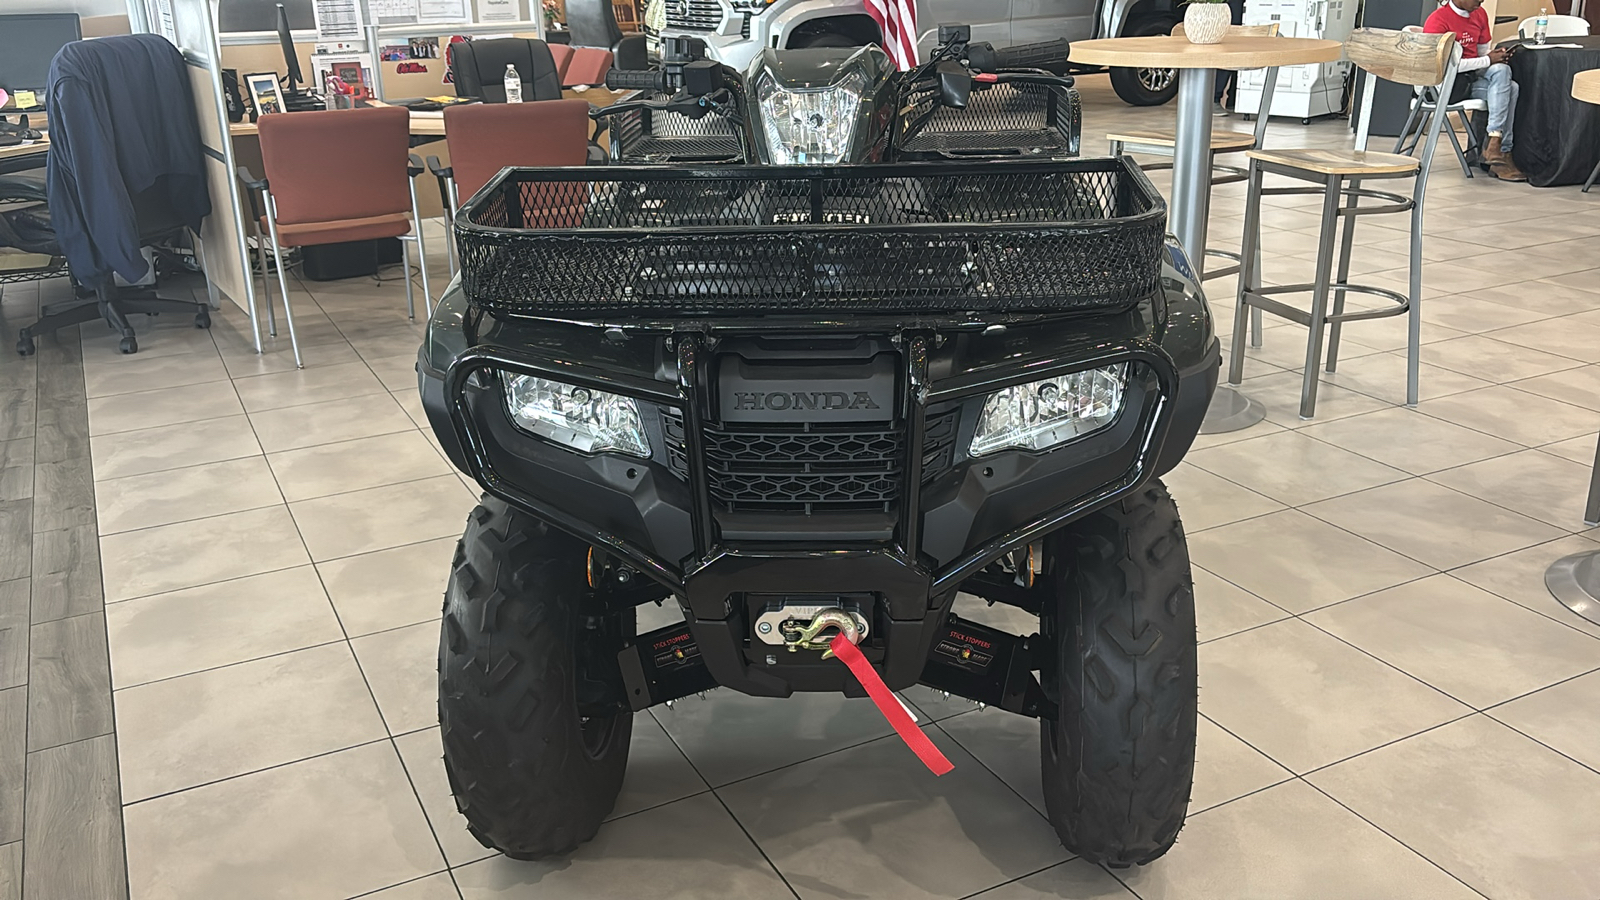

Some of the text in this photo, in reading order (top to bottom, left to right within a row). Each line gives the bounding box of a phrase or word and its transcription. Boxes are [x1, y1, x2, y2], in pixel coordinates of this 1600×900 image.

[734, 391, 880, 410] HONDA
[950, 631, 991, 649] STICK STOPPERS
